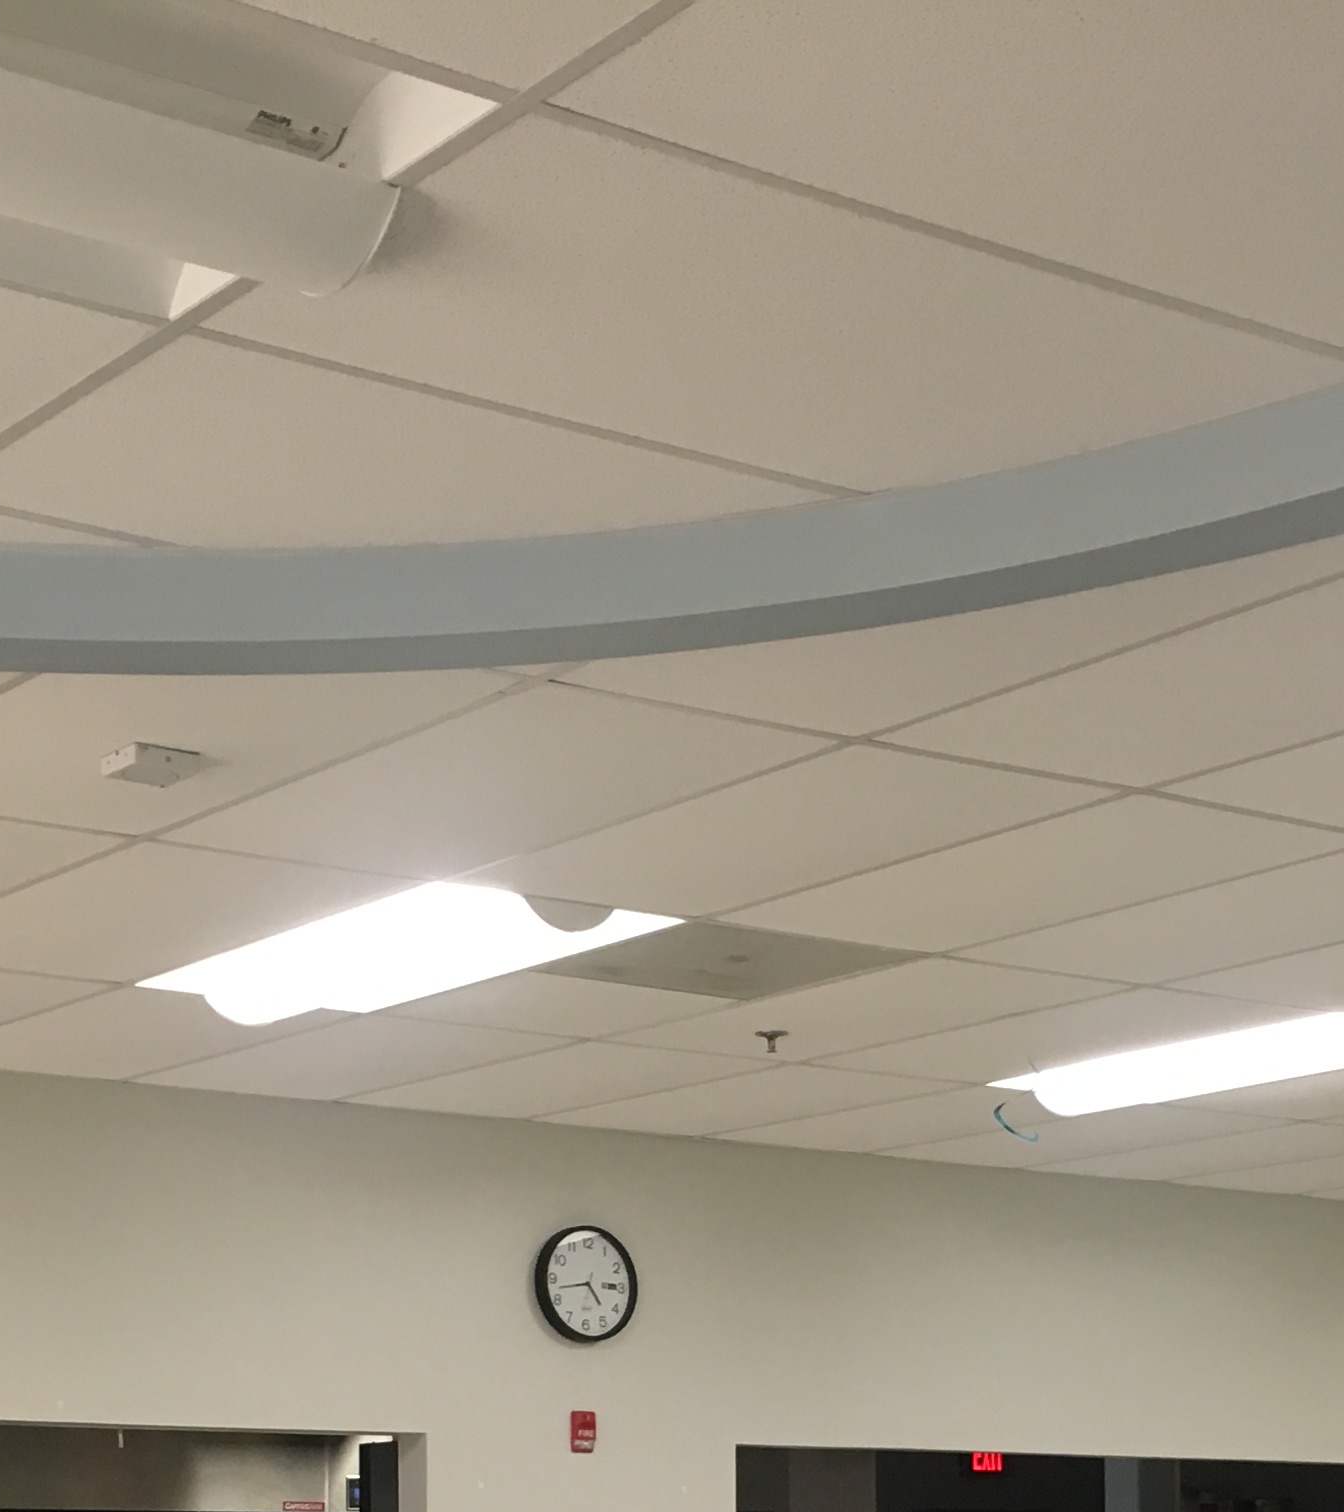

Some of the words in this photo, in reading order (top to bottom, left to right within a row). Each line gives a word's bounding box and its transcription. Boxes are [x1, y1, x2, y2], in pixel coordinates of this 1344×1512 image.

[258, 110, 291, 127] PHILIPS
[568, 1242, 576, 1252] 11
[583, 1238, 594, 1250] 12
[603, 1246, 607, 1257] 1
[555, 1254, 567, 1267] 10
[613, 1262, 621, 1274] 2
[549, 1272, 557, 1284] 9
[618, 1283, 625, 1294] 3
[554, 1294, 562, 1306] 8
[612, 1303, 619, 1314] 4
[566, 1311, 573, 1323] 7
[599, 1316, 607, 1328] 5
[582, 1319, 590, 1331] 6
[578, 1429, 594, 1438] FIRE
[972, 1451, 1002, 1471] EXIT
